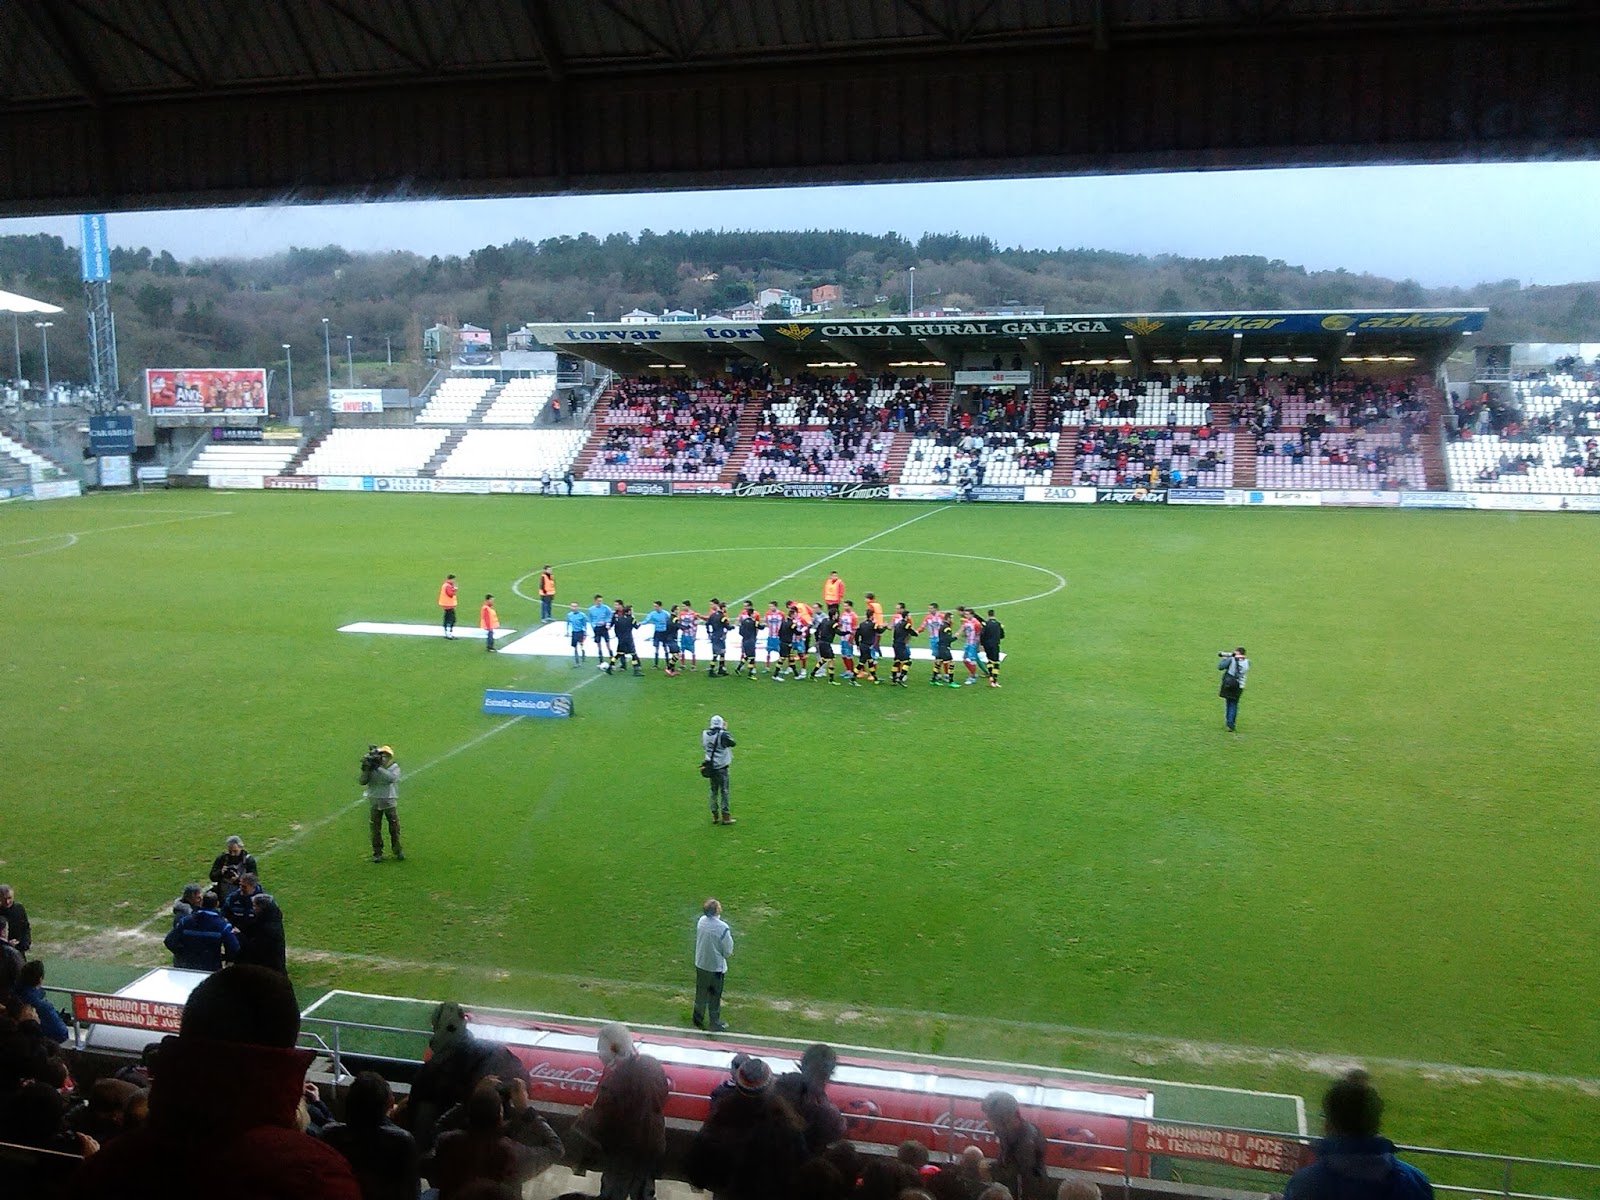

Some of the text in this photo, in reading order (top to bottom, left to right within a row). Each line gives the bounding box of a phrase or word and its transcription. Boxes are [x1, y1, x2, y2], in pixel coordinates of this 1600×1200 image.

[821, 321, 1111, 337] CAIXA RURAL GALEGA
[1188, 316, 1287, 331] azkar
[1359, 313, 1467, 328] azkar
[564, 328, 662, 341] torvar
[85, 997, 184, 1019] PROHIBIDO EL ACCES
[87, 1008, 182, 1029] AL TERRENO DE JUE
[1146, 1122, 1300, 1160] PROHIBIDO EL ACCESO
[1145, 1136, 1299, 1172] AL TERRENO DE JUEGO
